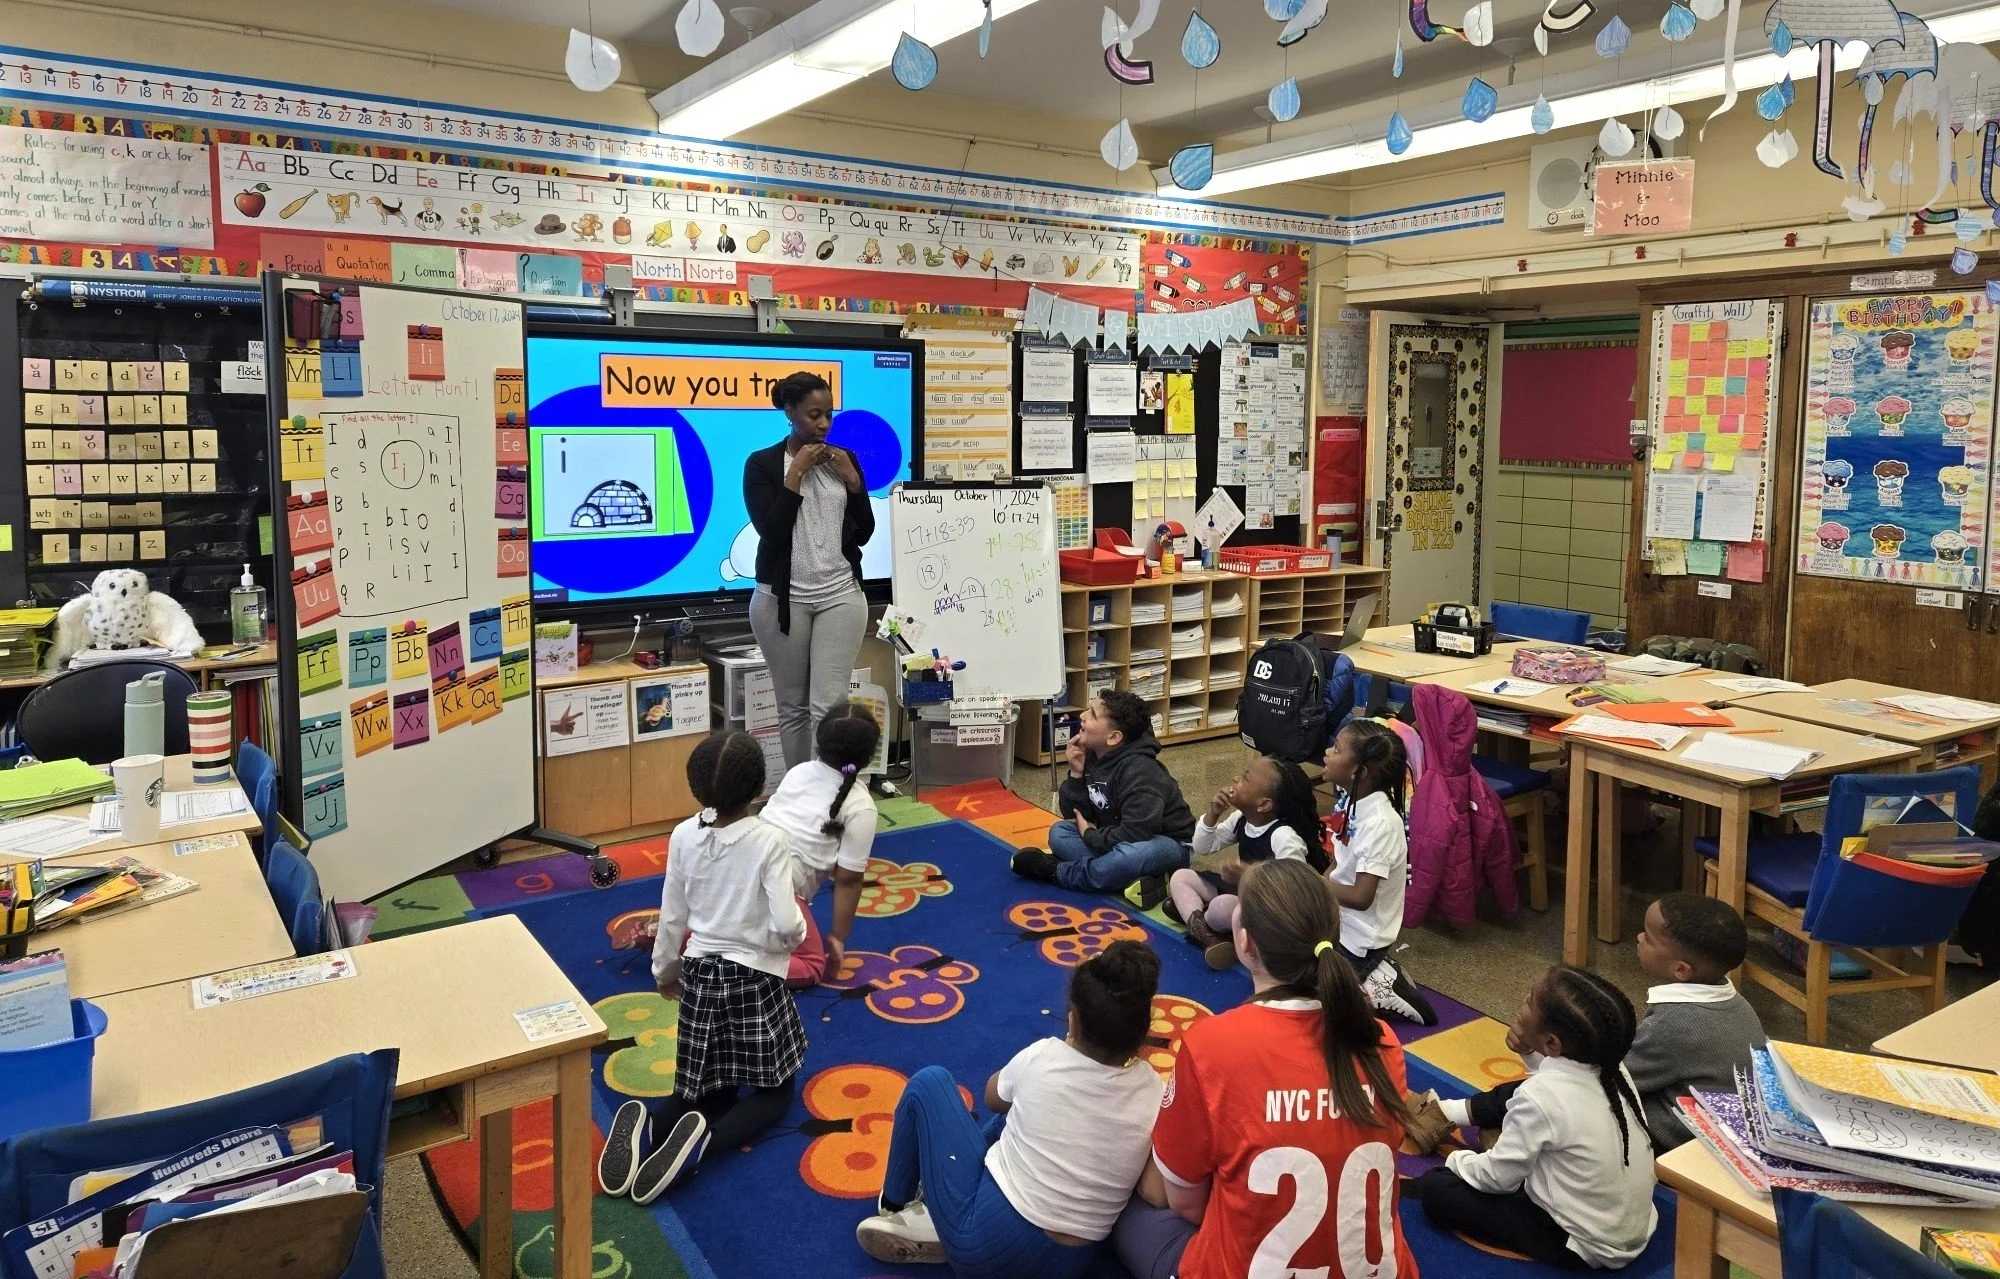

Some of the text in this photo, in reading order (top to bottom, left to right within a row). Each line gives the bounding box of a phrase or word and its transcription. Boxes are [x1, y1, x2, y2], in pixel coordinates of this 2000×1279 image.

[19, 72, 755, 170] 13 15 20 25 30 40 50
[24, 133, 56, 149] Rules
[64, 136, 76, 150] for
[80, 143, 105, 156] using
[142, 150, 153, 158] or
[157, 147, 172, 161] ck
[177, 148, 193, 162] for
[1, 152, 40, 167] sound.
[13, 169, 45, 185] almost
[50, 172, 83, 191] always
[89, 177, 99, 188] in
[101, 176, 120, 189] the
[125, 177, 170, 196] beginning
[170, 181, 180, 195] of
[1616, 170, 1674, 184] Minnie
[27, 192, 58, 202] comes
[63, 190, 95, 205] before
[237, 150, 1128, 254] Aa Bb Cc Dd Ee Ff Gg Hh Ii Jj Kk Mm Nn Pp Qu qu Yy Zz
[1637, 193, 1650, 205] &
[0, 206, 212, 229] comes at the end of a word after a short
[1571, 211, 1585, 220] clock
[1624, 213, 1660, 227] Moo
[284, 254, 323, 274] Period
[336, 256, 391, 271] Quotation
[415, 264, 455, 278] Comma
[636, 261, 681, 278] North
[690, 265, 733, 280] Norte
[470, 271, 516, 288] Exclamation
[531, 271, 567, 288] Question
[90, 287, 242, 303] NYSTROM HERFF JONES EDUCATION
[442, 297, 486, 322] October
[502, 309, 521, 323] 2024
[1032, 295, 1092, 329] WIT
[1342, 310, 1357, 319] Class
[1675, 303, 1749, 320] Graffiti Wall
[1869, 299, 1931, 313] HAPPY
[1110, 318, 1123, 335] &
[1142, 306, 1254, 338] WISDOM
[420, 343, 432, 365] Ii
[930, 349, 946, 357] bath
[287, 358, 322, 383] Mm
[332, 357, 351, 381] Ll
[367, 366, 478, 400] Letter Hunt!
[606, 365, 783, 405] Now you tr
[500, 384, 521, 404] Dd
[342, 415, 358, 423] Find
[360, 414, 370, 422] all
[372, 414, 385, 422] the
[292, 439, 314, 463] Tt
[501, 433, 521, 452] Ee
[1140, 446, 1149, 459] N
[1175, 446, 1185, 457] W
[500, 485, 524, 514] Gg
[897, 491, 943, 513] Thursday
[954, 490, 988, 501] October
[1011, 490, 1040, 506] 2024
[1413, 491, 1453, 511] SHINE
[295, 515, 327, 539] Aa
[1406, 510, 1455, 531] BRIGHT
[1412, 531, 1455, 551] IN 223
[501, 544, 524, 563] Oo
[1438, 633, 1457, 642] Caddy
[397, 640, 424, 663] Bb
[306, 650, 330, 678] Ff
[354, 649, 381, 680] Pp
[1254, 660, 1273, 680] DG
[675, 691, 693, 699] pinky
[590, 701, 623, 711] forefinger
[974, 711, 998, 719] listening
[354, 716, 388, 740] Ww
[315, 796, 338, 828] Jj
[1266, 1085, 1376, 1123] NYC FOY
[260, 1139, 270, 1148] 10
[152, 1128, 262, 1181] Hundreds Board
[266, 1153, 277, 1162] 20
[1247, 1141, 1398, 1279] 20
[33, 1222, 53, 1237] SI
